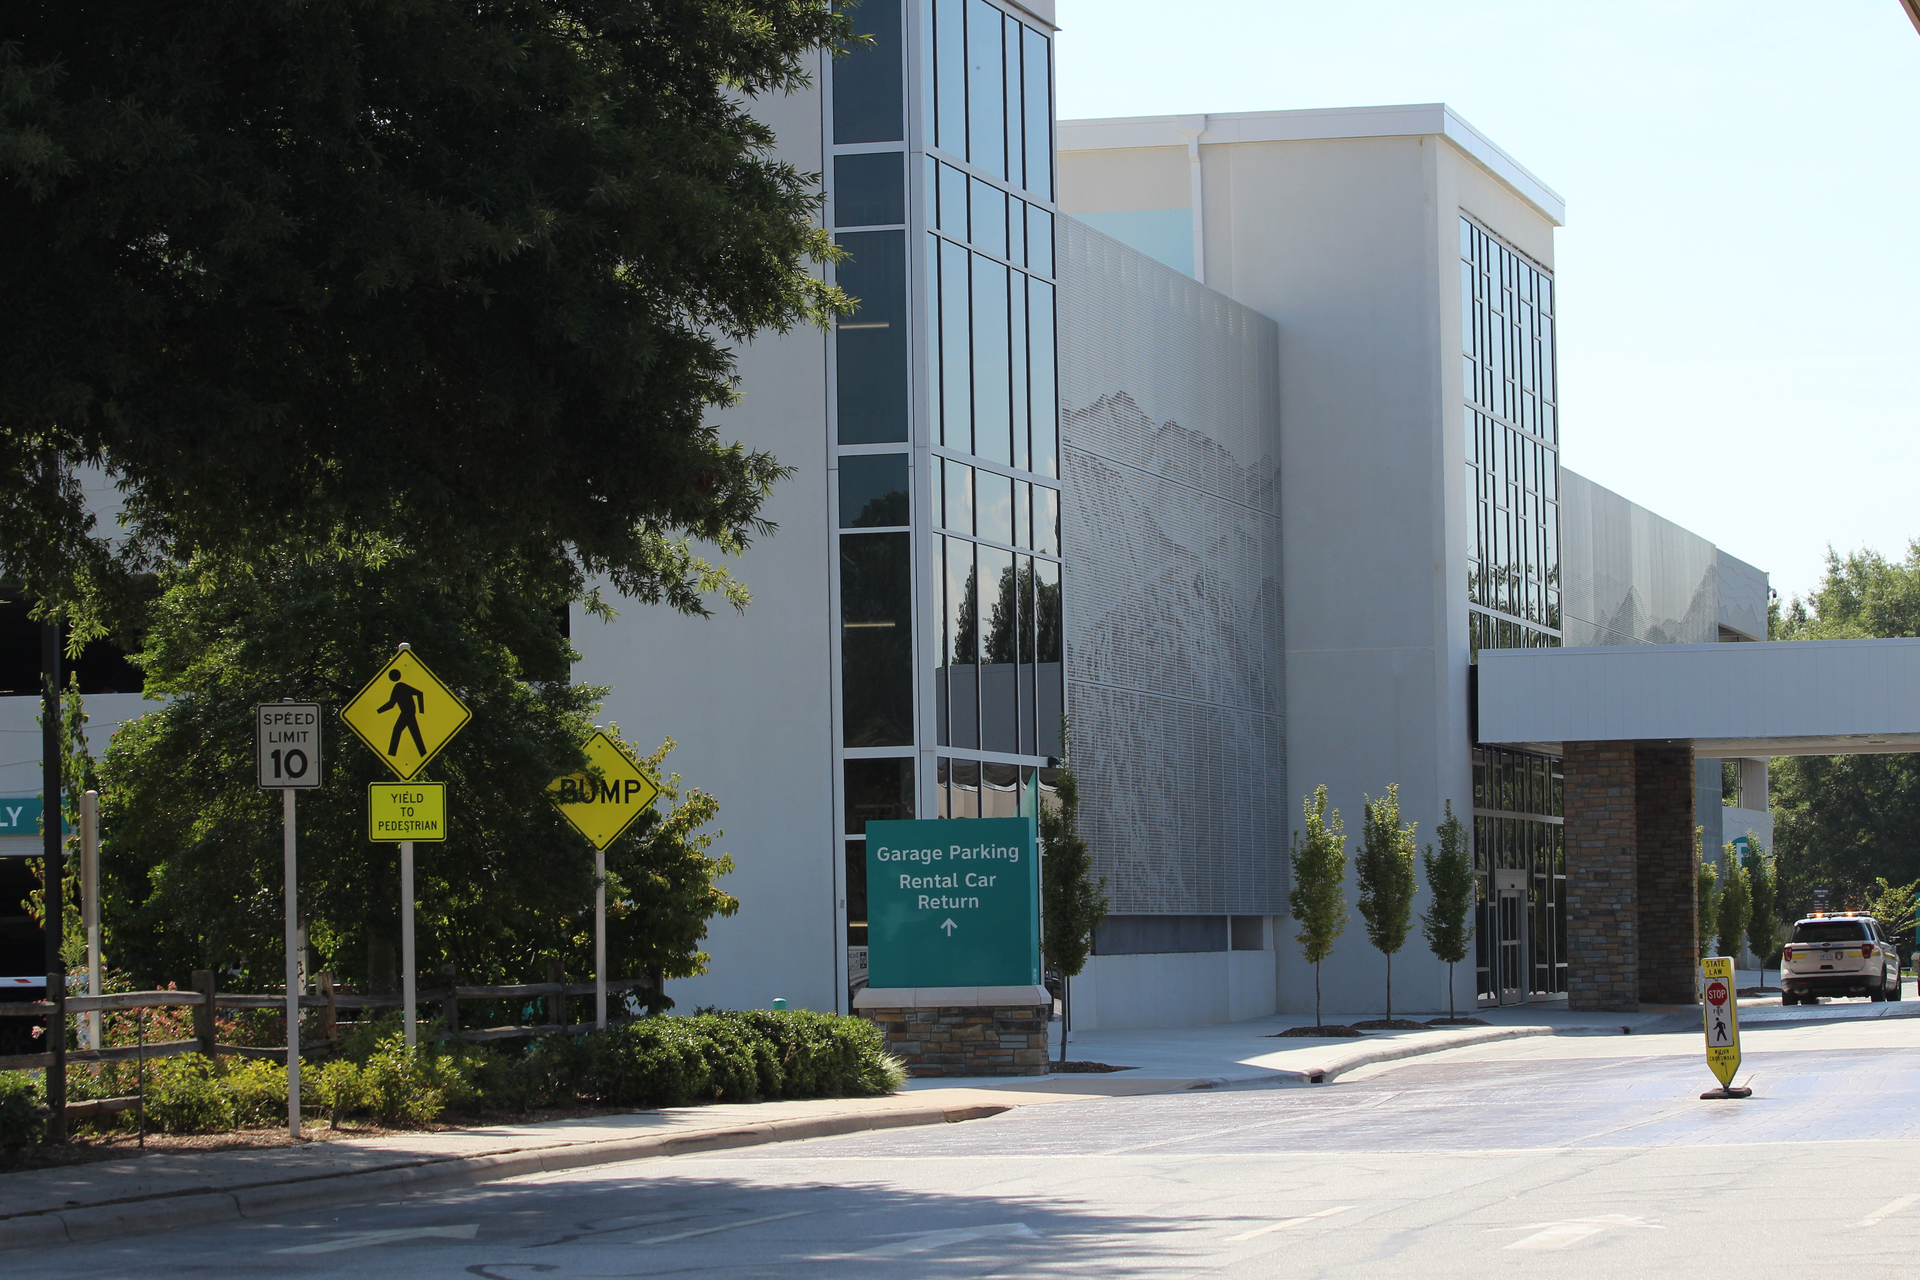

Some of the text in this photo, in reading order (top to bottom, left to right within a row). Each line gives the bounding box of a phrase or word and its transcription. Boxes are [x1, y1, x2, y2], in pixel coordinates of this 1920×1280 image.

[263, 713, 315, 725] SPEED
[269, 731, 309, 743] LIMIT
[271, 748, 308, 778] 10
[560, 778, 641, 804] BUMP
[390, 793, 424, 804] YIELD
[400, 806, 415, 817] TO
[378, 820, 437, 831] PEDESTRIAN
[877, 844, 1019, 865] Garage Parking
[900, 872, 997, 889] Rental Car
[918, 894, 979, 910] Return
[1705, 960, 1725, 968] STATE
[1708, 989, 1726, 999] STOP
